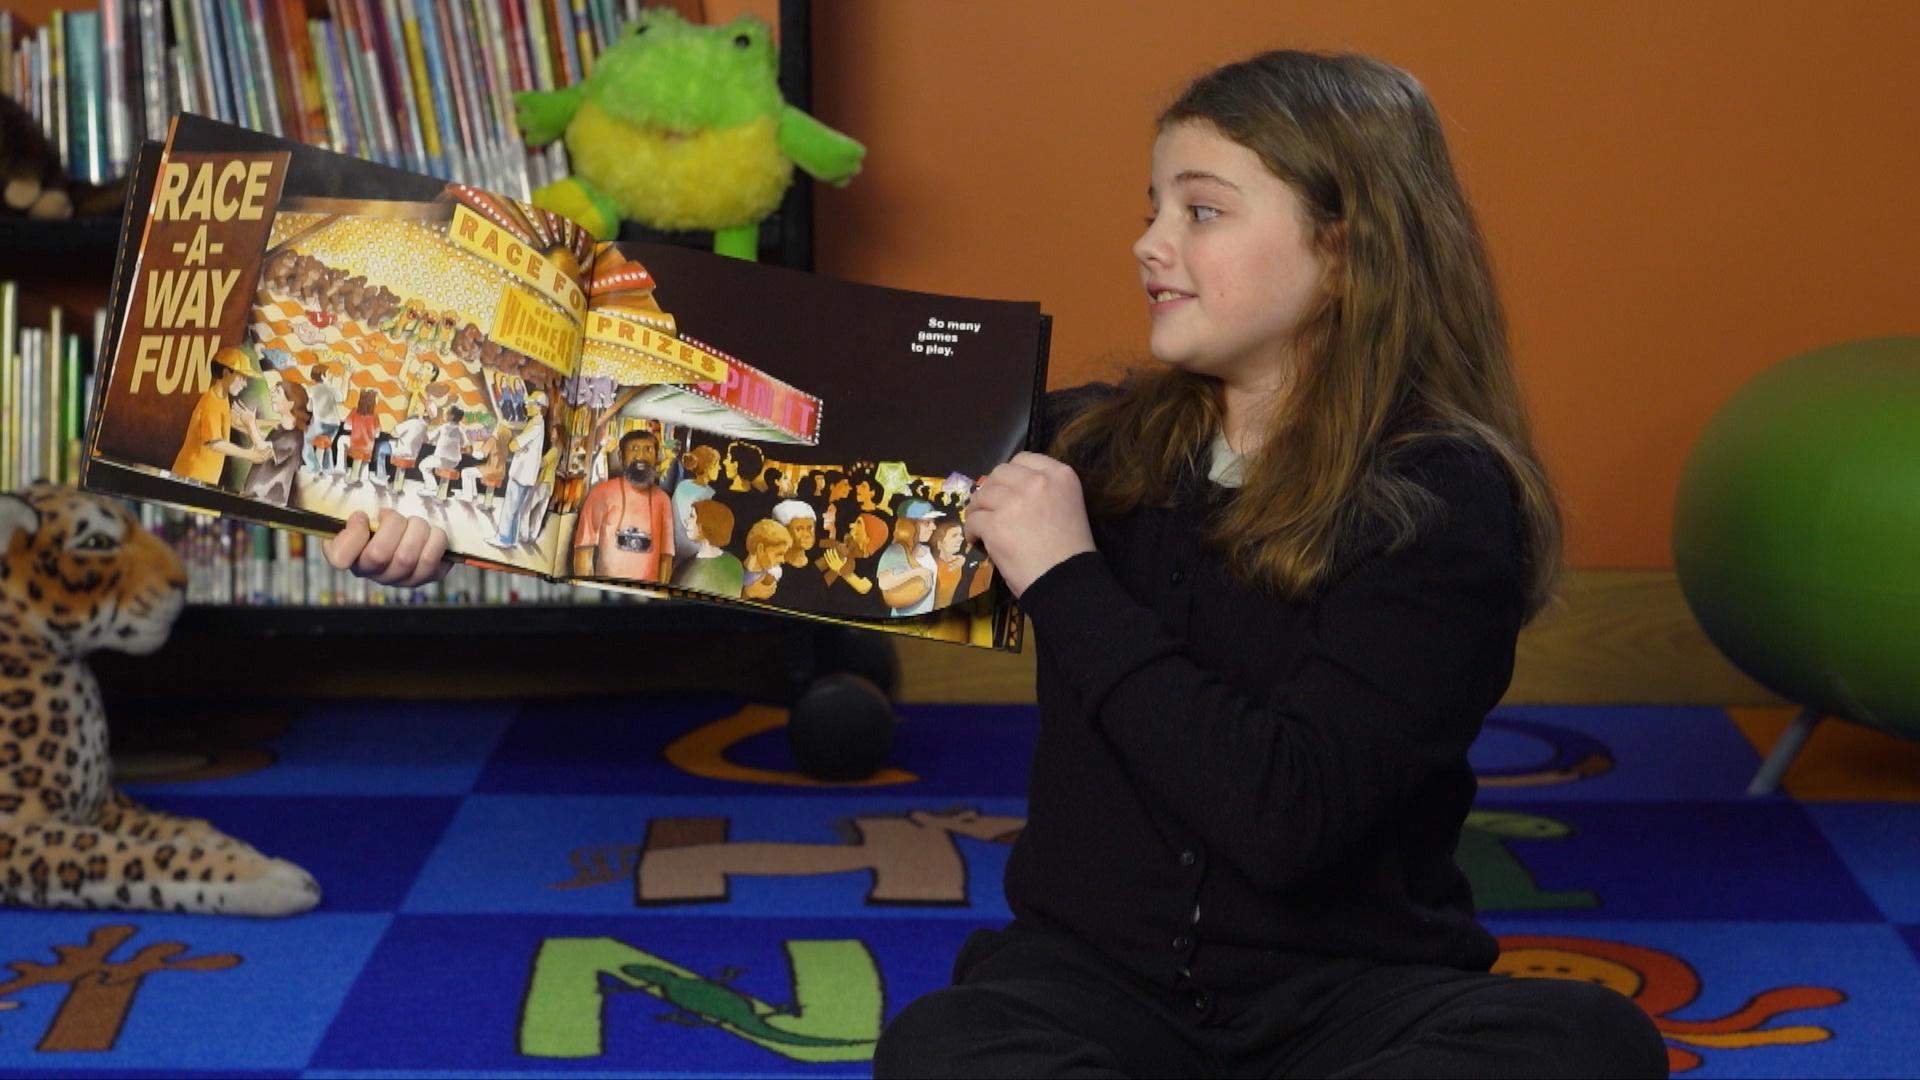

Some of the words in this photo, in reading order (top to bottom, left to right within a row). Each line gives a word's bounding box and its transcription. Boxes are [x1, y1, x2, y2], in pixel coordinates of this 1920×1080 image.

[154, 160, 273, 222] RACE
[173, 224, 223, 266] -A-
[459, 213, 543, 281] RACE
[144, 269, 242, 328] WAY
[499, 288, 576, 371] WINNERS
[515, 337, 557, 362] CHOICE
[597, 316, 717, 373] PRIZES
[911, 342, 924, 353] to
[926, 344, 954, 357] play.
[917, 331, 958, 342] games
[928, 317, 945, 328] So
[947, 320, 981, 333] many
[130, 336, 221, 395] FUN
[783, 395, 815, 434] IT
